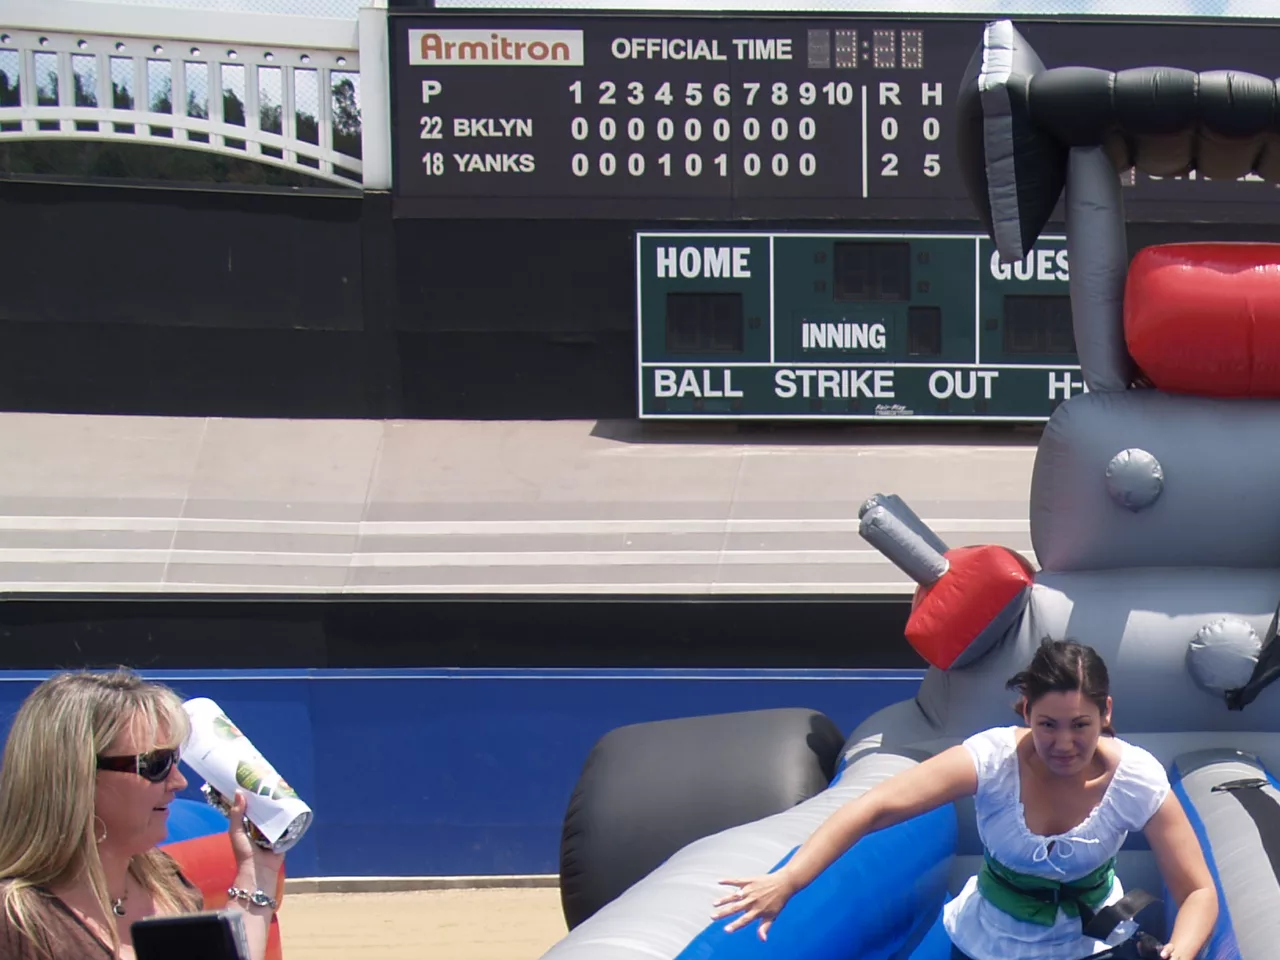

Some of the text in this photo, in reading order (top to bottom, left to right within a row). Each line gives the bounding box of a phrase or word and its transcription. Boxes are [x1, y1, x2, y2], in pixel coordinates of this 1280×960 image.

[420, 32, 570, 61] Armitron
[611, 37, 793, 61] OFFICIAL TIME
[421, 80, 943, 107] P 1 2 3 4 5 6 7 8 9 10 R H
[420, 115, 940, 142] 22 BKLYN 0 0 0 0 0 0 0 0 0 0 0
[422, 152, 941, 177] 18 YANKS 0 0 0 1 0 1 0 0 0 2 5
[656, 246, 752, 279] HOME
[990, 249, 1070, 282] GUES
[802, 322, 886, 350] INNING
[654, 369, 1090, 400] BALL STRIKE OUT H-
